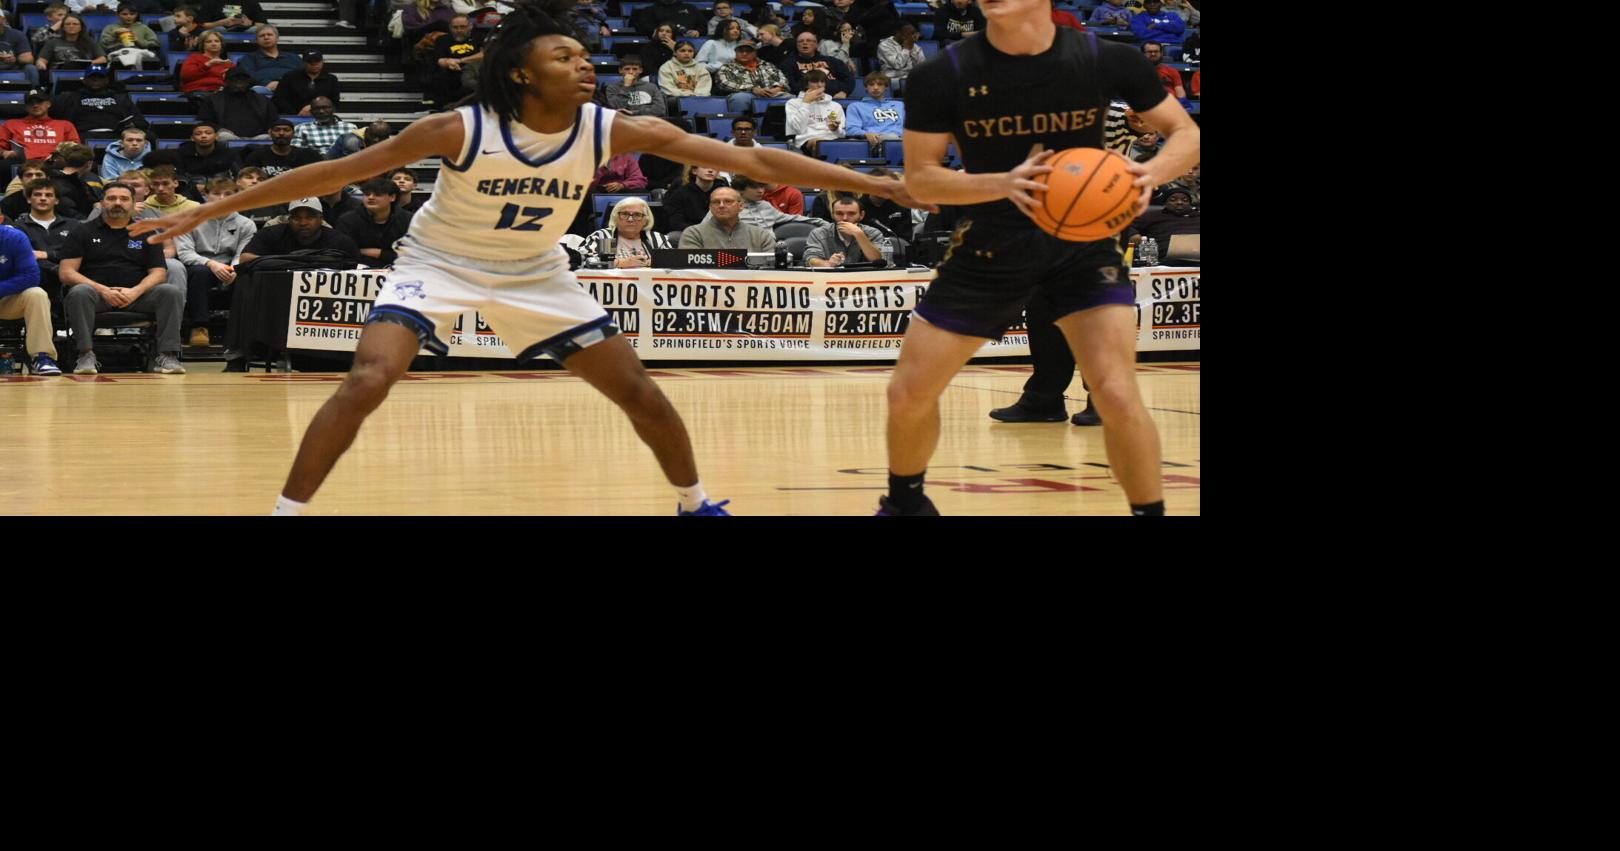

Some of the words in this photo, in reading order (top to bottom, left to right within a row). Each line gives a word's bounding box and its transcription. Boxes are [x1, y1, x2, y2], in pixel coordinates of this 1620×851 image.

[963, 108, 1099, 138] CYCLONES
[477, 177, 584, 201] GENERALS
[494, 202, 553, 231] 12
[687, 254, 715, 265] POSS.
[299, 271, 386, 297] SPORTS
[577, 282, 638, 306] ADIO
[652, 283, 736, 308] SPORTS
[746, 286, 811, 309] RADIO
[824, 285, 905, 309] SPORTS
[653, 311, 810, 334] 92.3FM/1450AM
[652, 338, 733, 349] SPRINGFIELD'S
[823, 339, 902, 349] SPRINGFIELD'S
